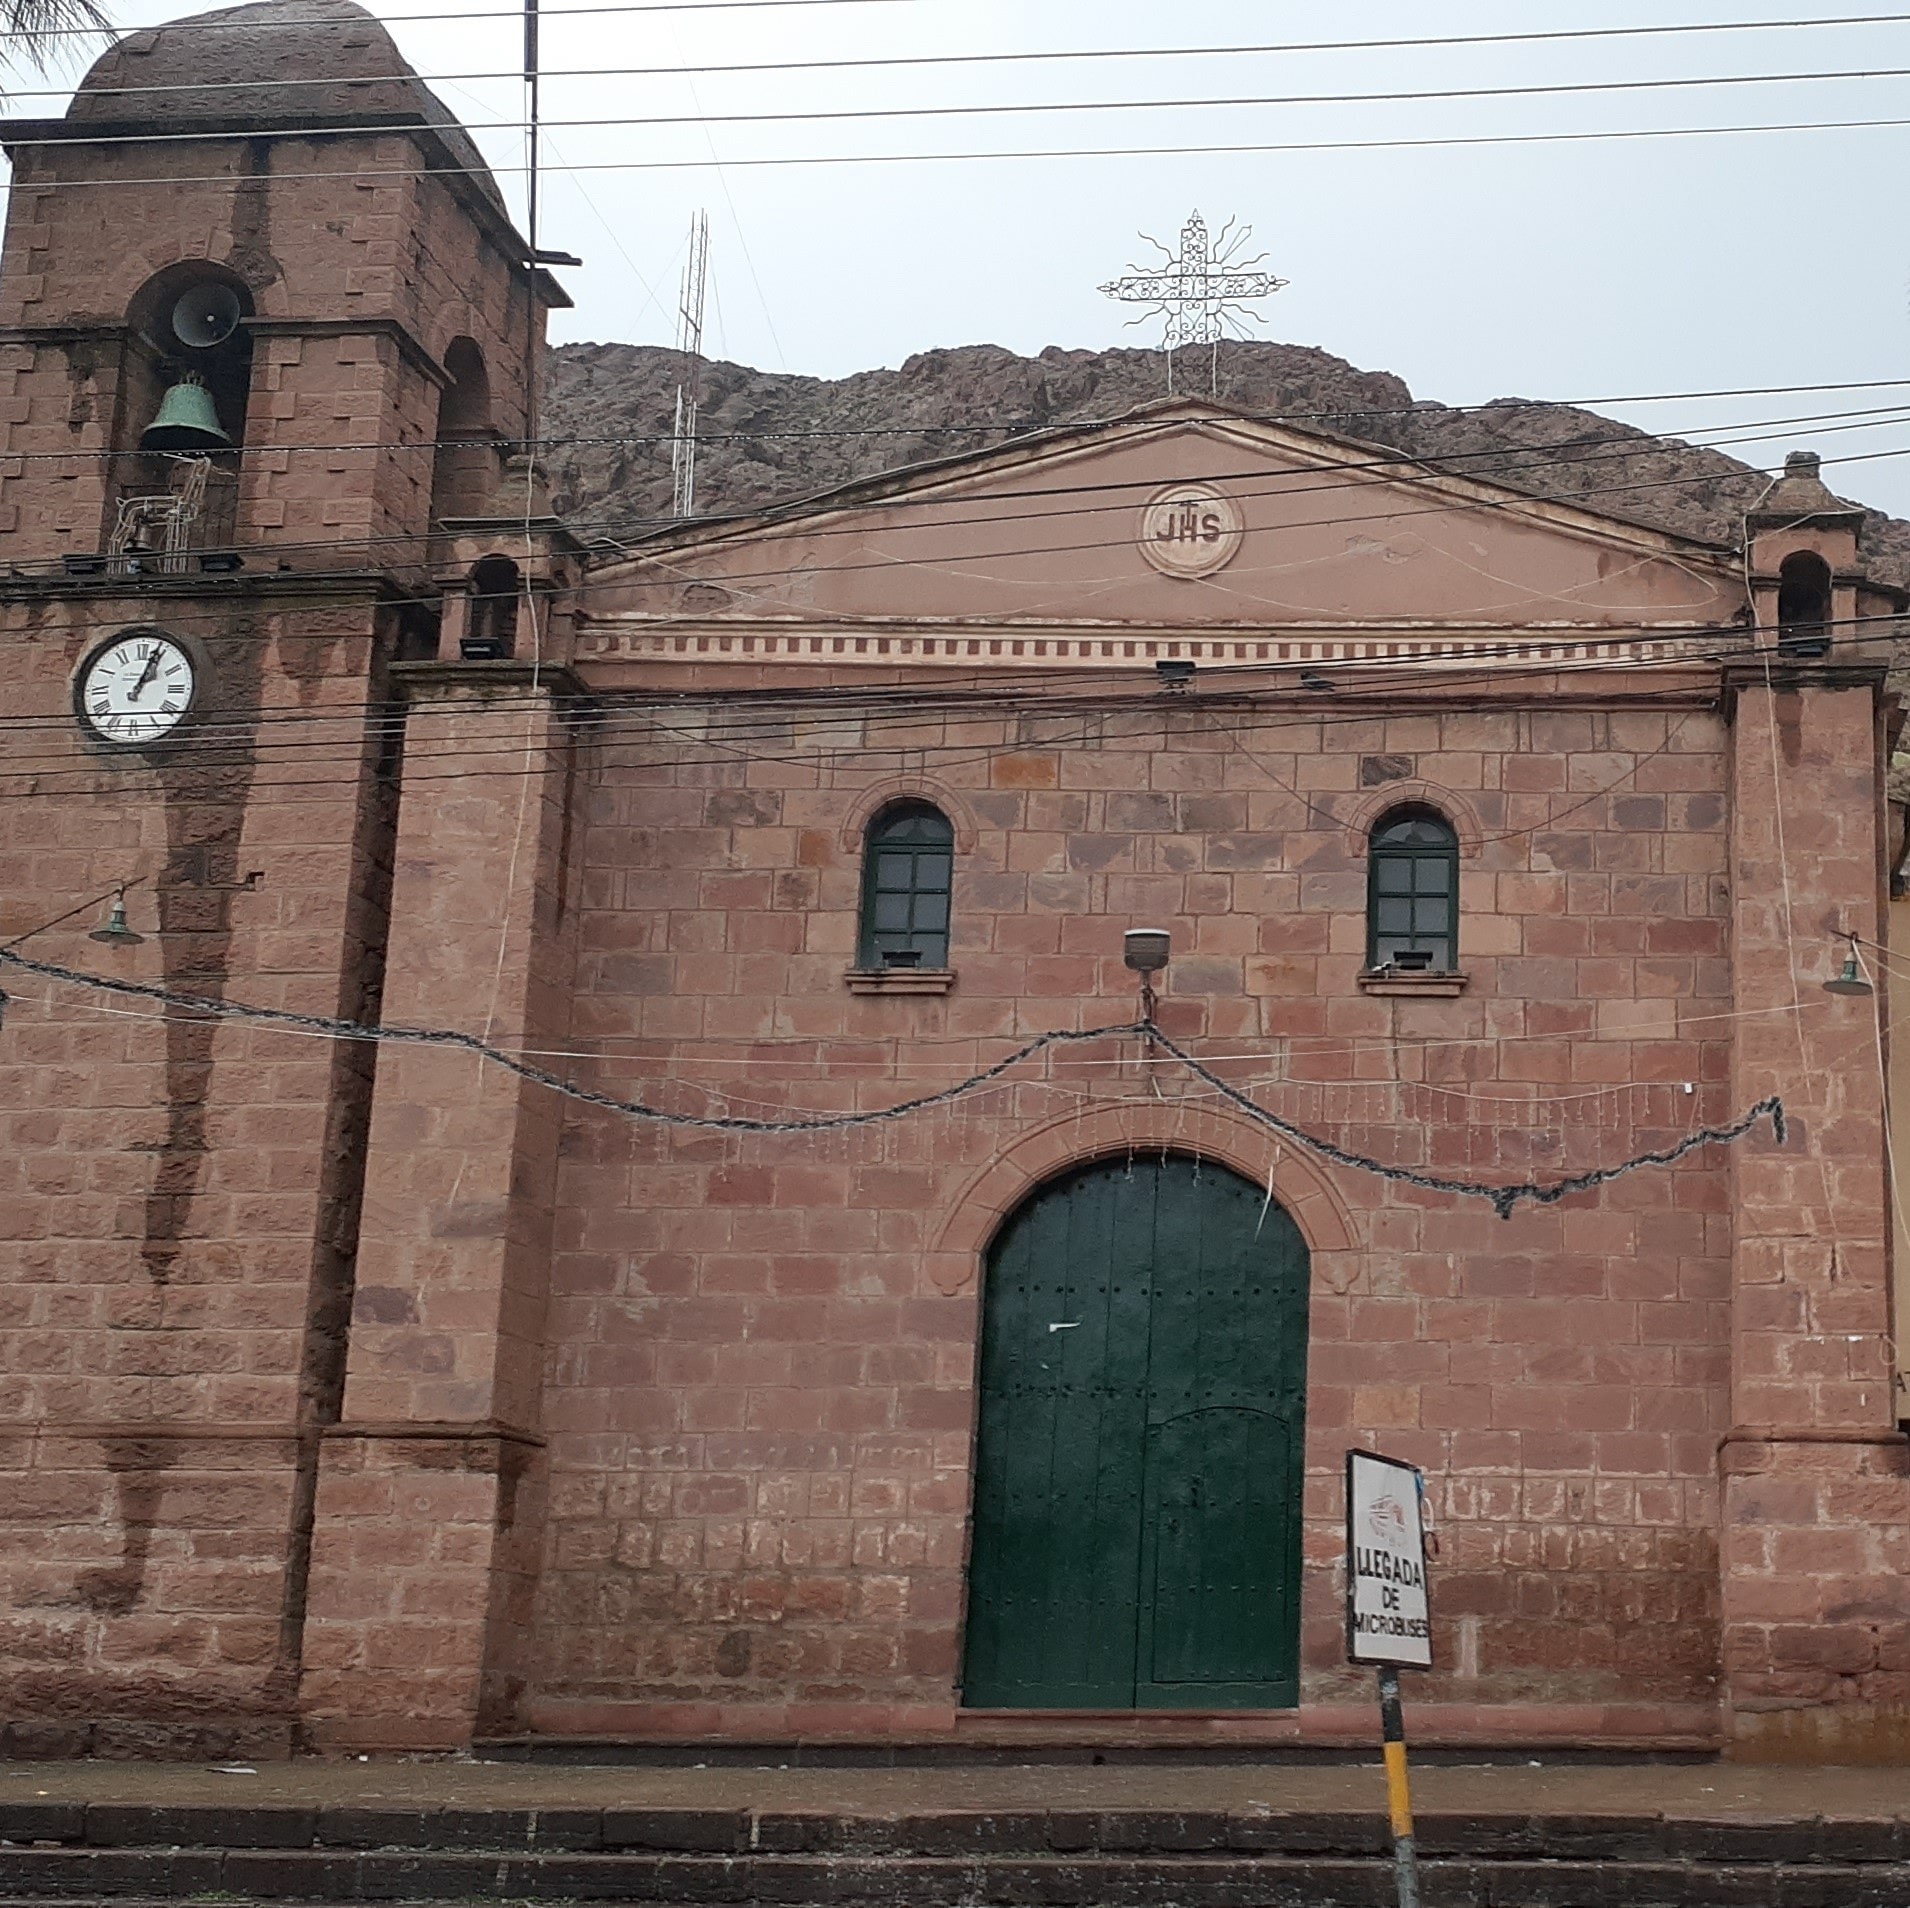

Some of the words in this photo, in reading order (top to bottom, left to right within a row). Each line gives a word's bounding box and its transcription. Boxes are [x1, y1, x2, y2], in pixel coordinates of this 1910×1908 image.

[1356, 1546, 1424, 1590] LLEGADA
[1382, 1586, 1400, 1611] DE
[1352, 1612, 1428, 1638] MICROBUSES
